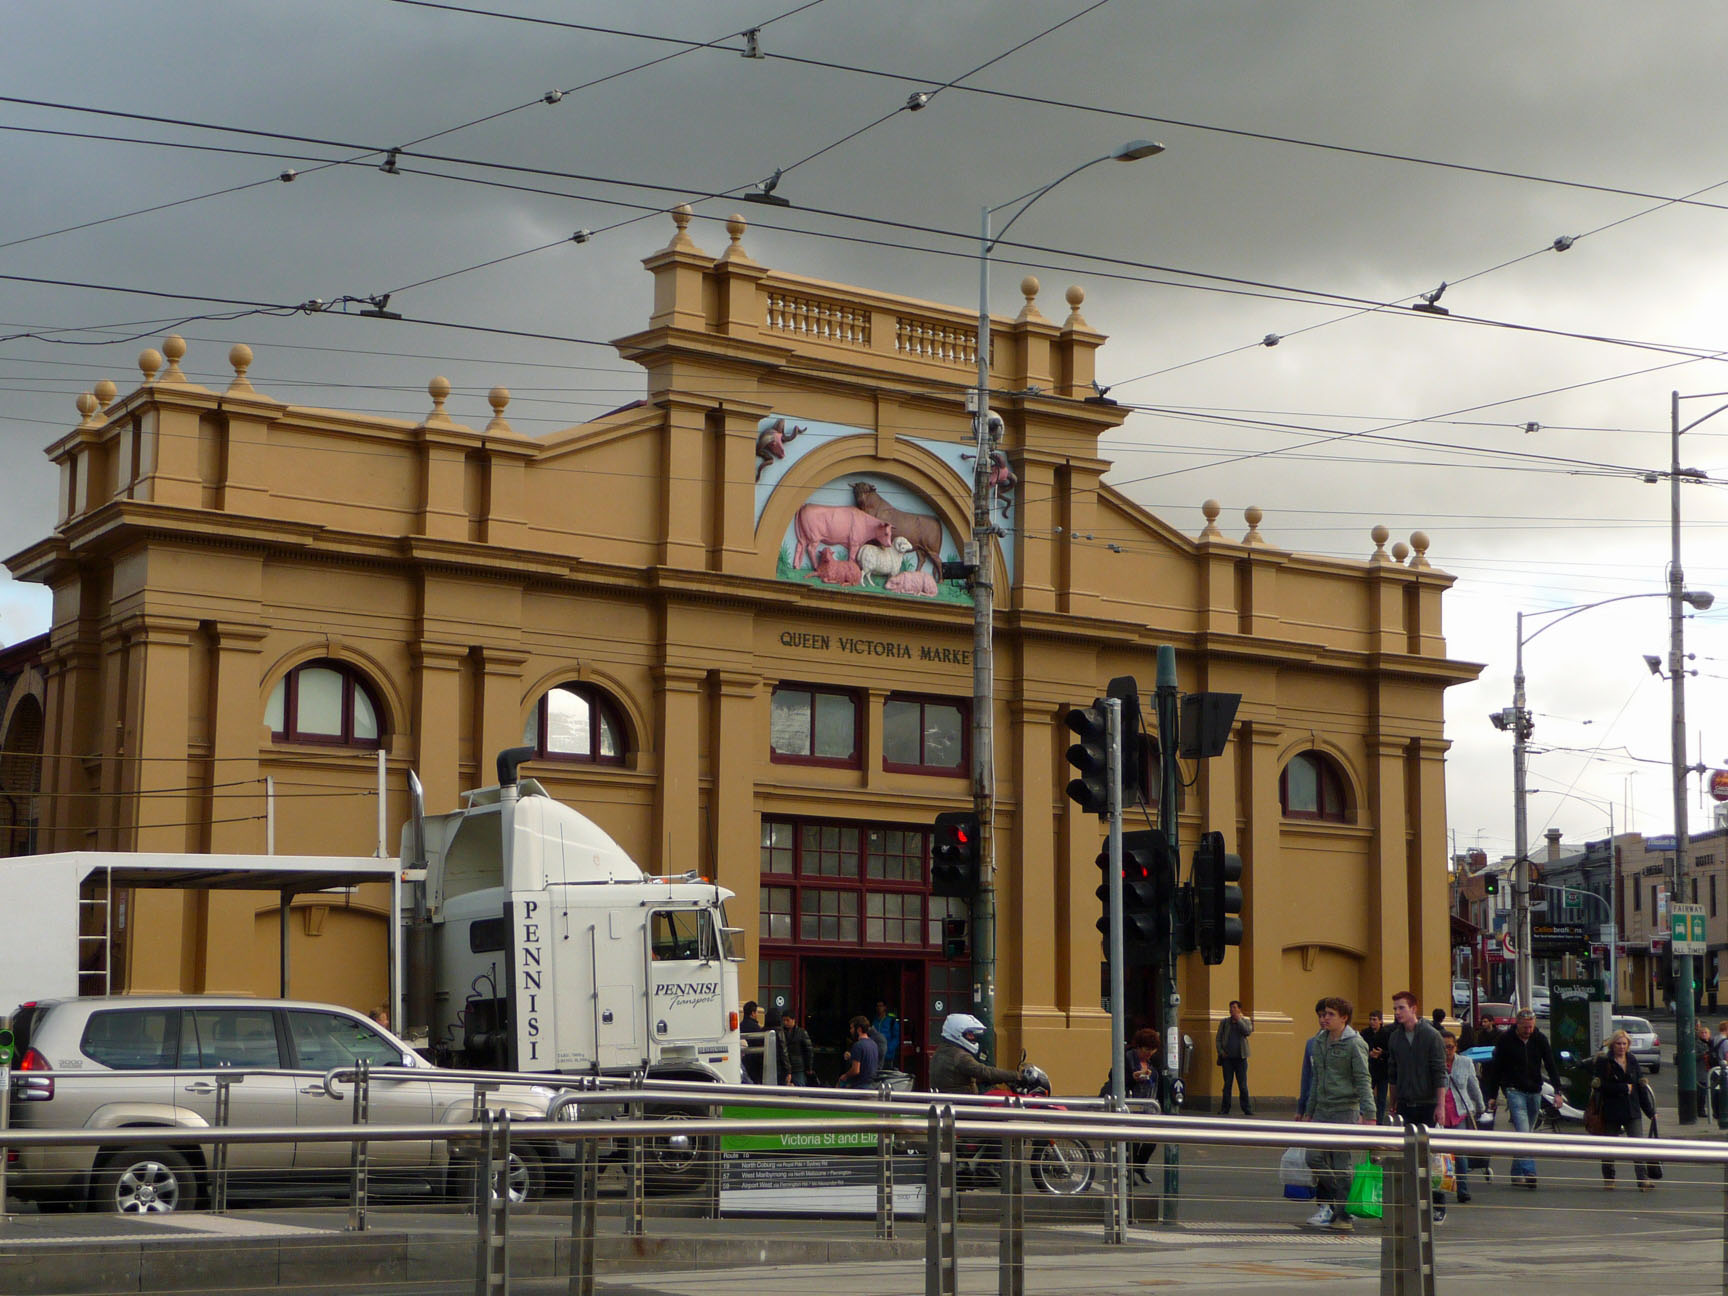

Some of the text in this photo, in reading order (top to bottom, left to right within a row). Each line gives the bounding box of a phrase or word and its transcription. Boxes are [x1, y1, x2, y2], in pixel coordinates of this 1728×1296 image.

[780, 631, 975, 665] QUEEN VICTORIA MARKE
[522, 900, 542, 1060] PENNISI
[654, 982, 719, 996] PENNISI
[1553, 984, 1596, 993] Queen Victoria
[669, 994, 720, 1010] Transport
[780, 1132, 820, 1145] Victoria
[823, 1132, 835, 1144] St
[838, 1132, 858, 1144] and
[915, 1186, 922, 1199] 7
